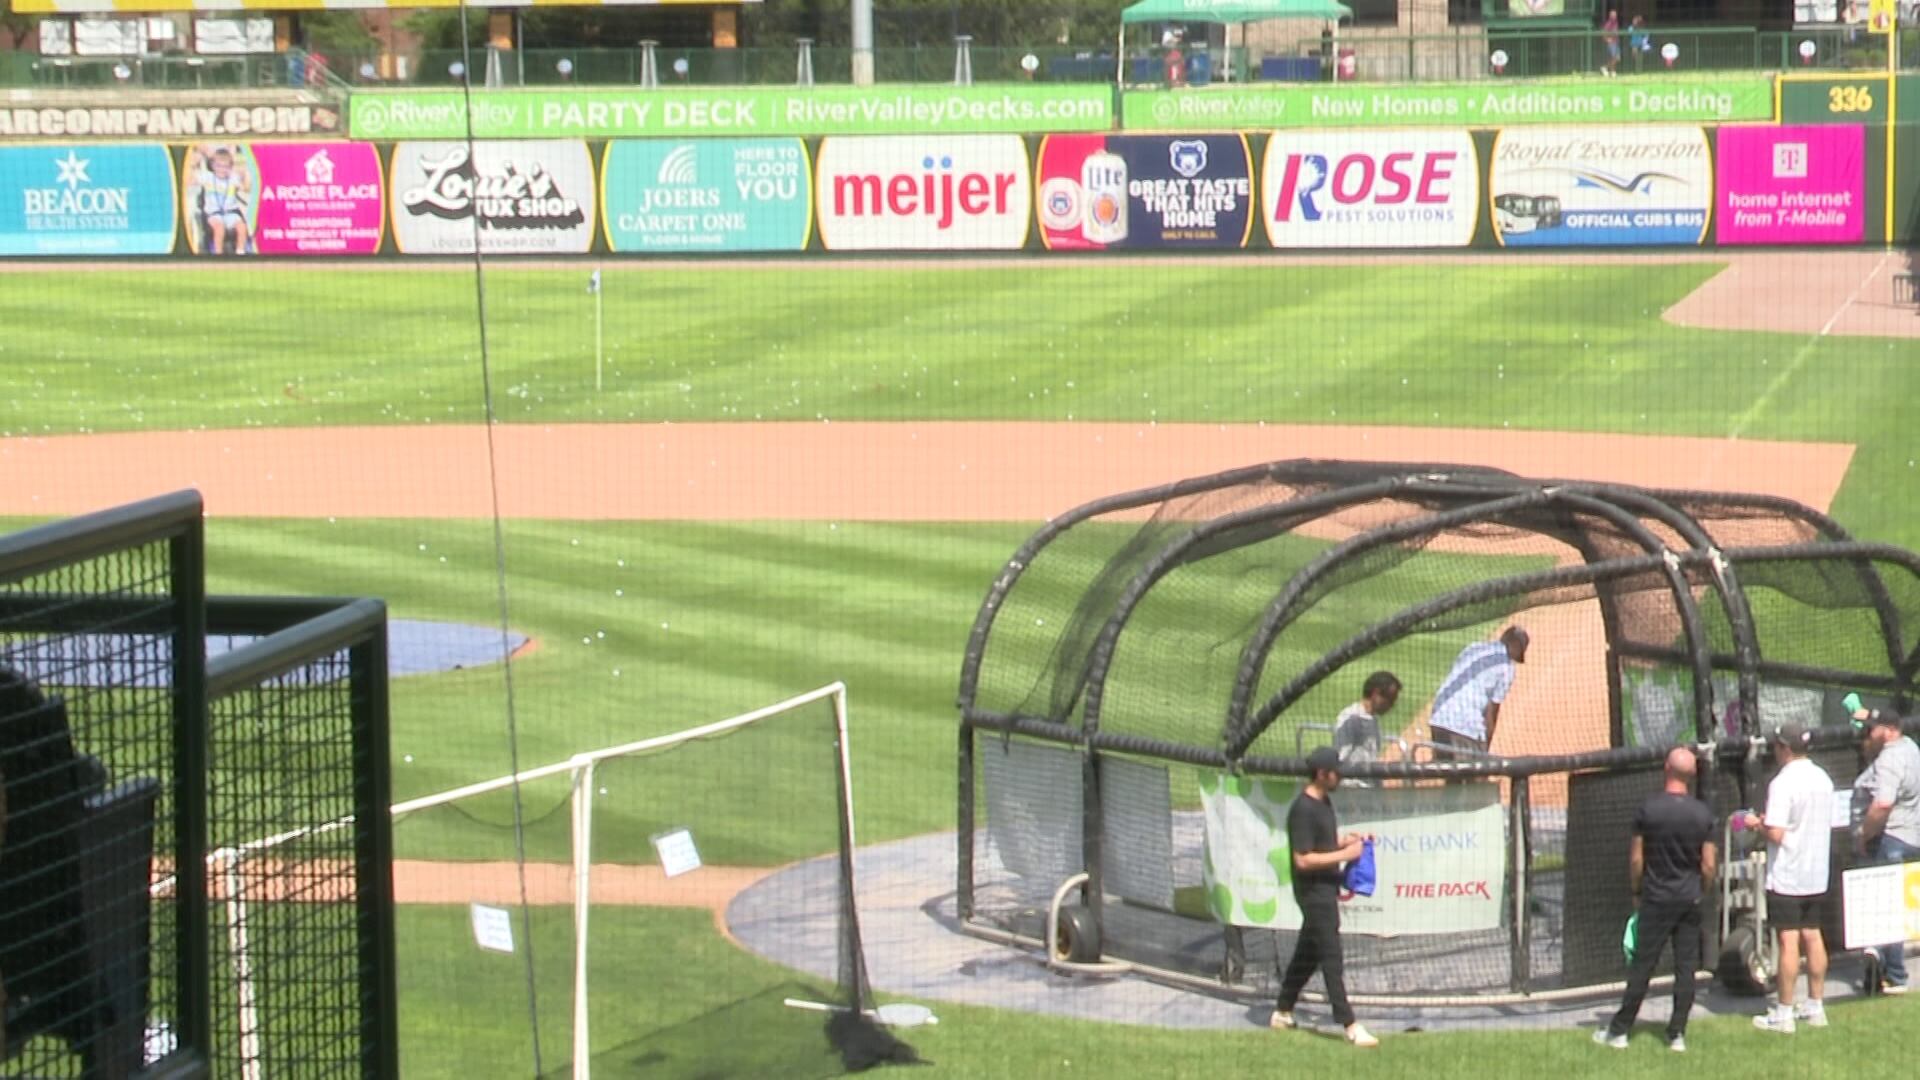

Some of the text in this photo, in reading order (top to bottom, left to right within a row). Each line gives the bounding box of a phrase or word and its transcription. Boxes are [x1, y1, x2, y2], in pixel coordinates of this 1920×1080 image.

[1311, 89, 1732, 117] New Homes Additions Decking
[1829, 86, 1873, 112] 336
[543, 99, 756, 129] PARTY DECK
[786, 97, 1105, 124] RiverValleyDecks.com
[734, 147, 798, 160] HERE TO
[1500, 138, 1704, 166] Royal Excursion
[735, 162, 799, 176] FLOOR
[1089, 166, 1123, 190] Lite
[262, 184, 379, 200] A ROSIE PLACE
[736, 178, 798, 201] YOU
[834, 156, 1016, 229] meijer
[1129, 179, 1249, 197] GREAT TASTE
[1274, 152, 1457, 222] ROSE
[24, 188, 130, 214] BEACON
[518, 197, 578, 216] SHOP
[640, 187, 720, 214] JOERS
[1143, 194, 1236, 212] THAT HITS
[1728, 190, 1852, 208] home internet
[618, 213, 746, 232] CARPET ONE
[1163, 211, 1217, 228] HOME
[1327, 209, 1455, 222] PEST SOLUTIONS
[1566, 212, 1704, 228] OFFICIAL CUBS BUS
[1734, 210, 1846, 226] from T-Mobile
[1420, 831, 1479, 852] BANK
[1394, 881, 1491, 900] TIRE RACK
